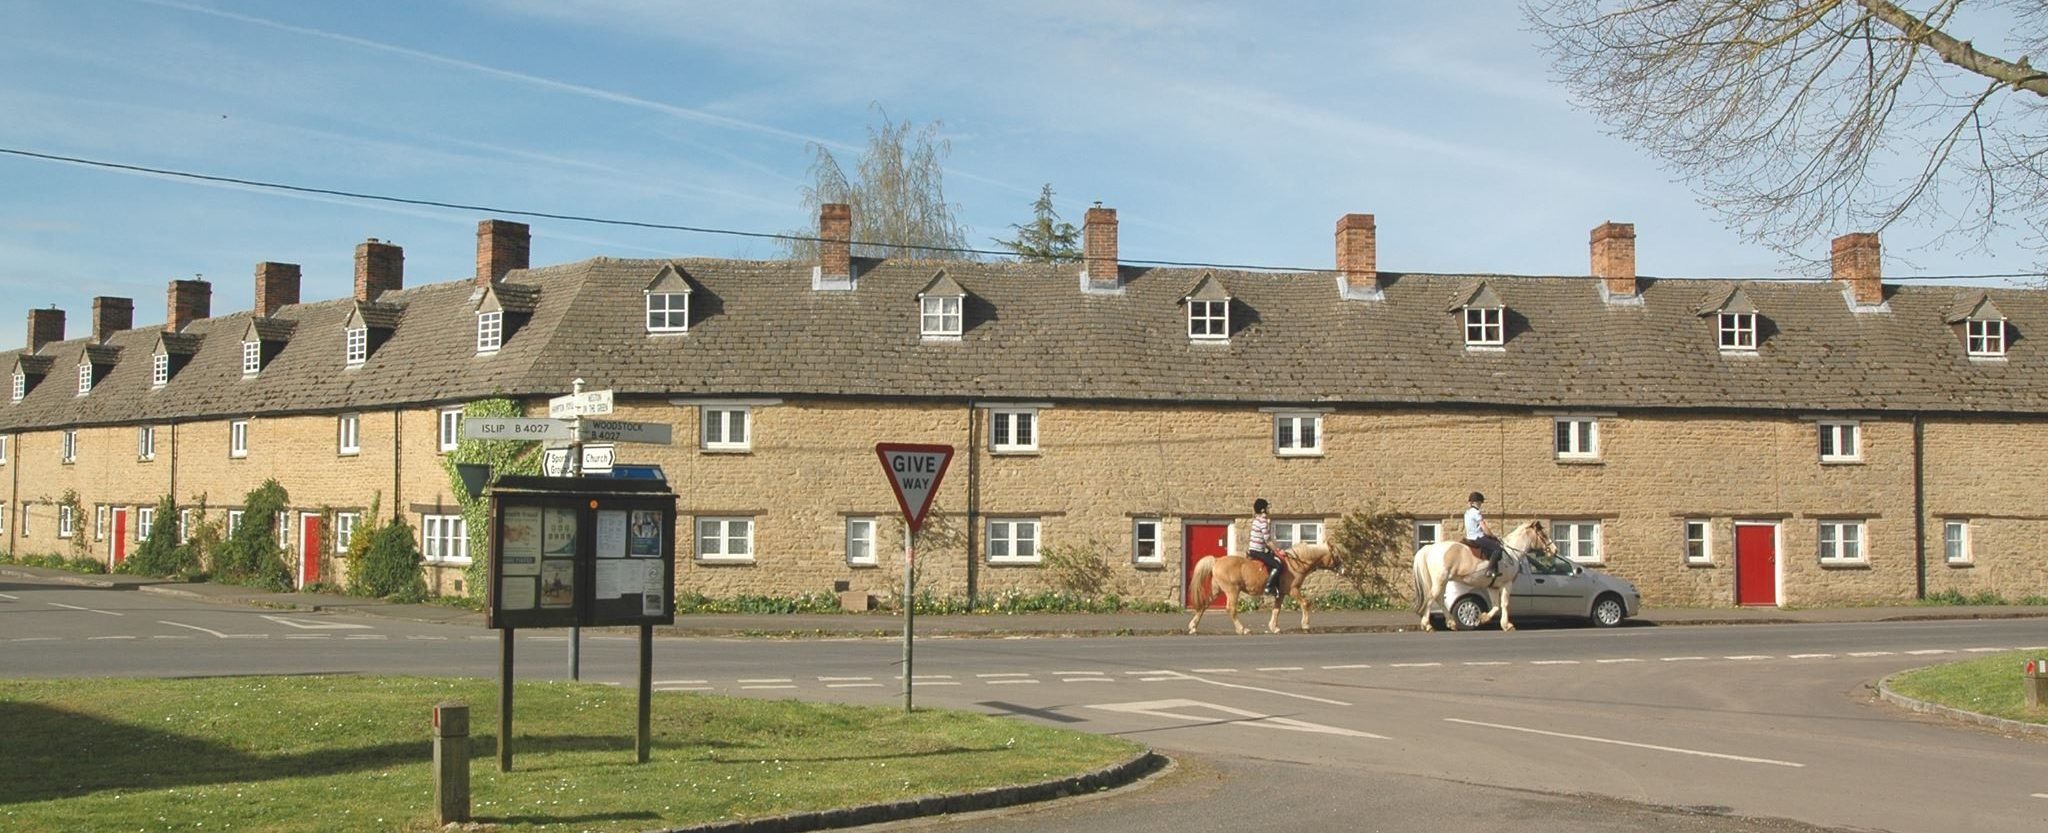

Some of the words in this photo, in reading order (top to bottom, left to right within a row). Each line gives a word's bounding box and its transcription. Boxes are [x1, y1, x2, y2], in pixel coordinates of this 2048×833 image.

[481, 424, 505, 433] ISLIP
[515, 424, 521, 433] B
[523, 424, 550, 433] 4027
[592, 420, 644, 432] WOODSTOCK
[592, 431, 597, 440] B
[599, 431, 620, 440] 4027
[585, 453, 608, 463] Church
[892, 455, 935, 473] GIVE
[902, 477, 929, 489] WAY
